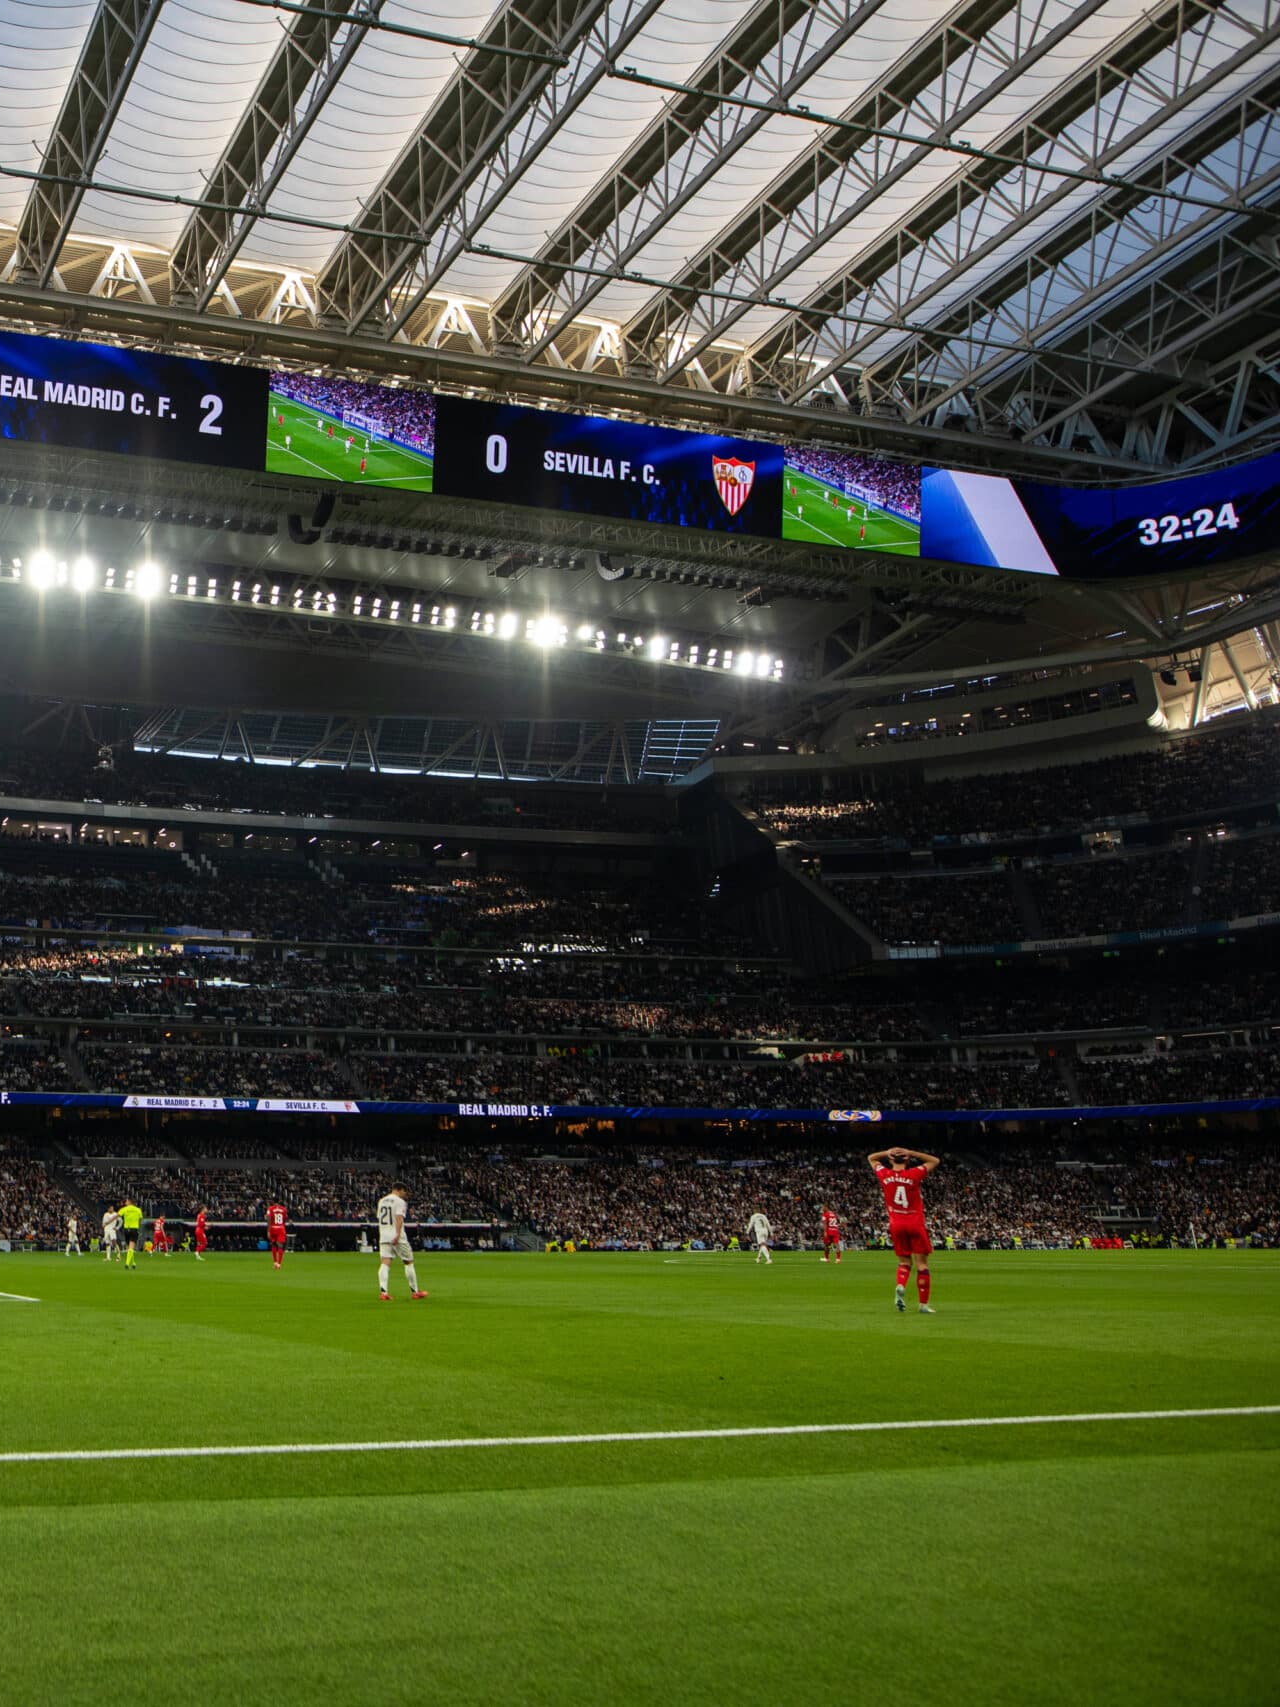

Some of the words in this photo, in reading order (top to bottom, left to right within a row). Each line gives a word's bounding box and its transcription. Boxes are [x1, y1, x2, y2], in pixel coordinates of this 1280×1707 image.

[43, 380, 125, 412] MADRID
[130, 393, 151, 416] C.
[157, 396, 177, 420] F.
[198, 394, 223, 435] 2
[486, 434, 508, 474] 0
[543, 450, 615, 479] SEVILLA
[619, 460, 636, 482] F.
[642, 464, 661, 486] C.
[1138, 502, 1240, 546] 32:24
[1, 1092, 12, 1105] F.
[212, 1100, 218, 1108] 2
[264, 1101, 270, 1109] 0
[458, 1103, 486, 1116] REAL
[487, 1104, 529, 1116] MADRID
[530, 1105, 542, 1117] C.
[543, 1105, 553, 1117] F.
[893, 1185, 910, 1209] 4
[274, 1213, 284, 1225] 18
[380, 1206, 393, 1226] 21
